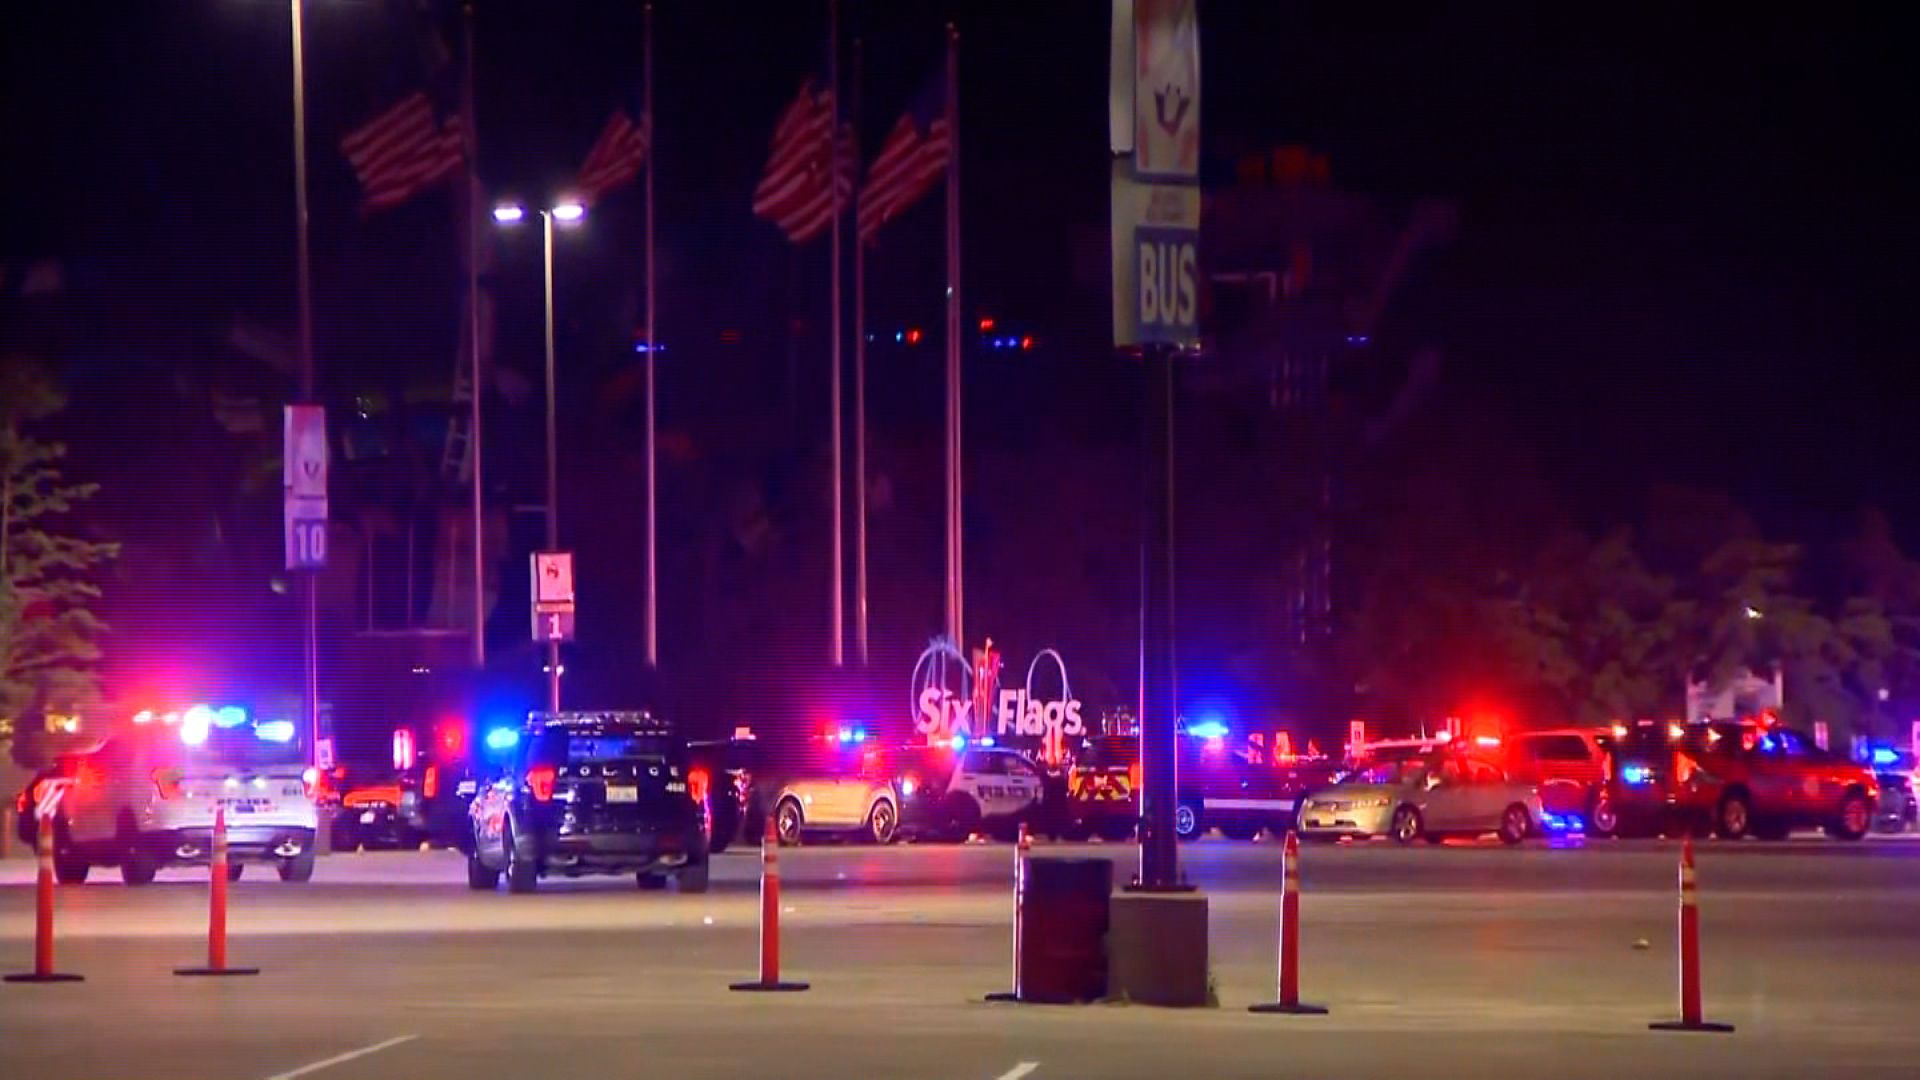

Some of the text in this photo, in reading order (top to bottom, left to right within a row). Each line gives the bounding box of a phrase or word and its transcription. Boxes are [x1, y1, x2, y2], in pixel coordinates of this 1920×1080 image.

[1140, 242, 1195, 325] BUS
[296, 523, 325, 562] 10
[548, 613, 563, 639] 1
[917, 687, 1082, 756] Six Flags
[559, 766, 679, 777] POLICE
